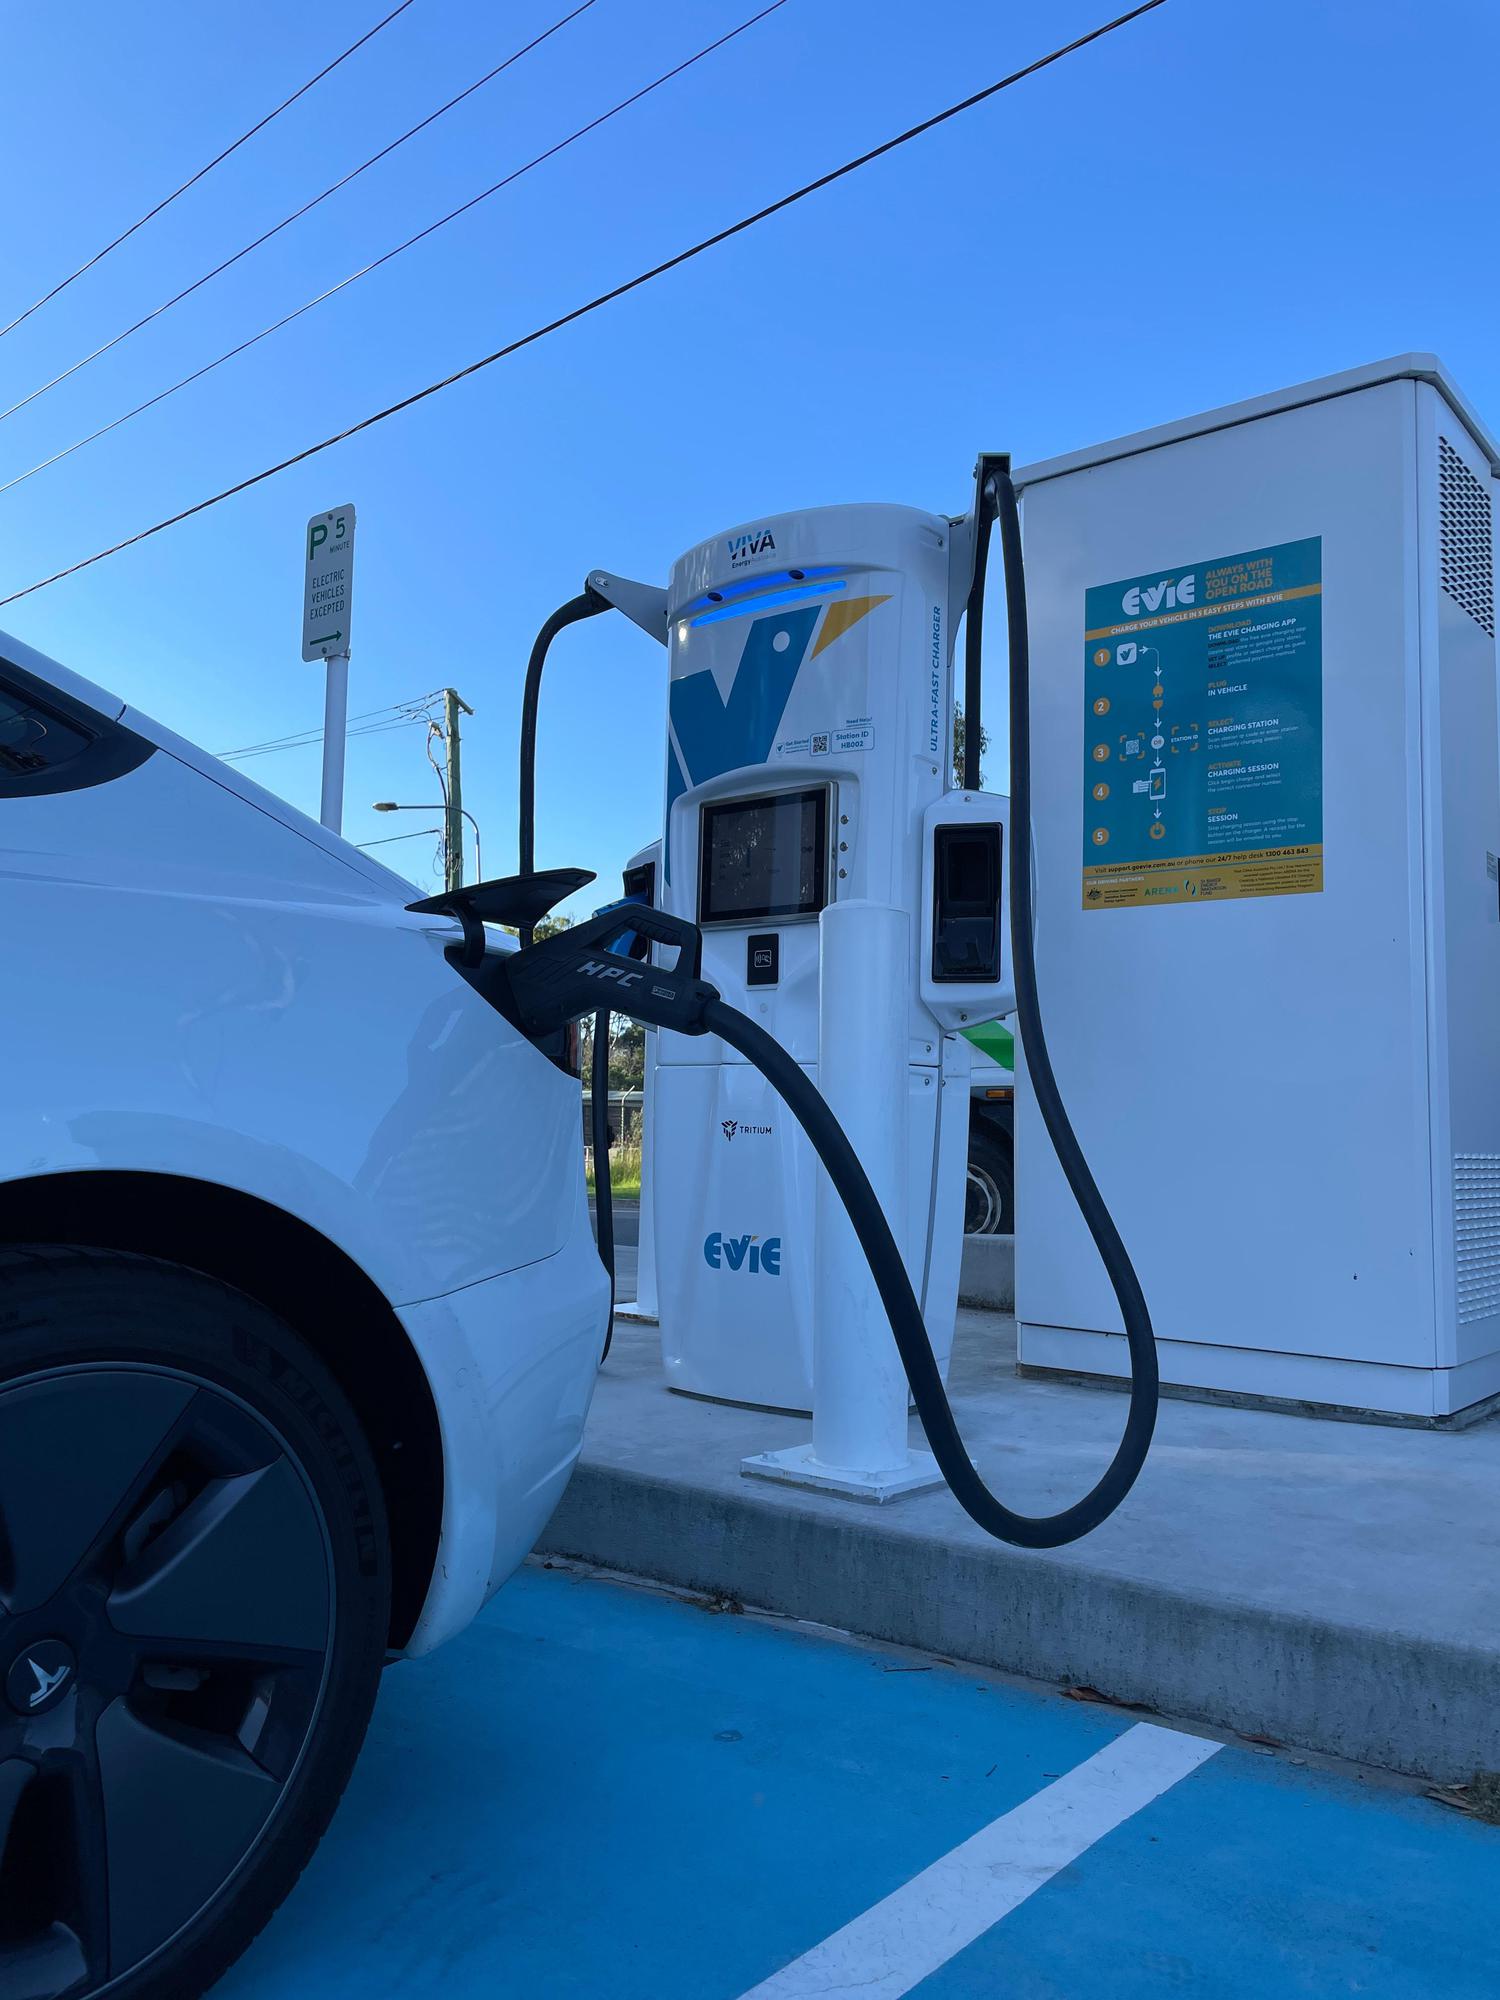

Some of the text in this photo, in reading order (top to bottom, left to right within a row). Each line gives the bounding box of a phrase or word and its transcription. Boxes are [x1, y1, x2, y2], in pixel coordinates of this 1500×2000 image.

[310, 517, 345, 560] P 5
[330, 540, 350, 553] MINUTE
[728, 530, 775, 560] VIVA
[1206, 558, 1272, 579] ALWAYS WITH
[312, 569, 344, 589] ELECTRIC
[1206, 568, 1272, 588] YOU ON THE
[312, 584, 344, 603] VEHICLES
[1206, 578, 1272, 599] OPEN ROAD
[310, 600, 344, 620] EXCEPTED
[1111, 594, 1283, 635] CHARGE YOUR VEHICLE IN 5 EASY STEPS WITH EVIE
[1208, 620, 1251, 632] DOWNLOAD
[1208, 618, 1297, 640] THE EVIE CHARGING APP
[1099, 653, 1104, 662] 1
[931, 606, 941, 752] ULTRA-FAST CHARGER
[1208, 680, 1227, 688] PLUG
[1217, 684, 1248, 695] VEHICLE
[1098, 702, 1104, 711] 2
[1208, 718, 1279, 735] CHARGING STATION
[836, 732, 859, 740] Station
[1098, 748, 1104, 757] 3
[1208, 762, 1279, 778] CHARGING SESSION
[1097, 787, 1104, 796] 4
[1208, 813, 1238, 823] SESSION
[1097, 832, 1103, 841] 5
[1095, 866, 1107, 874] Visit
[1184, 857, 1204, 866] phone
[1217, 854, 1232, 862] 24/7
[1233, 853, 1246, 862] help
[1266, 850, 1281, 858] 1300
[1282, 848, 1295, 856] 463
[577, 961, 643, 987] HPC
[740, 1126, 772, 1134] TRITIUM
